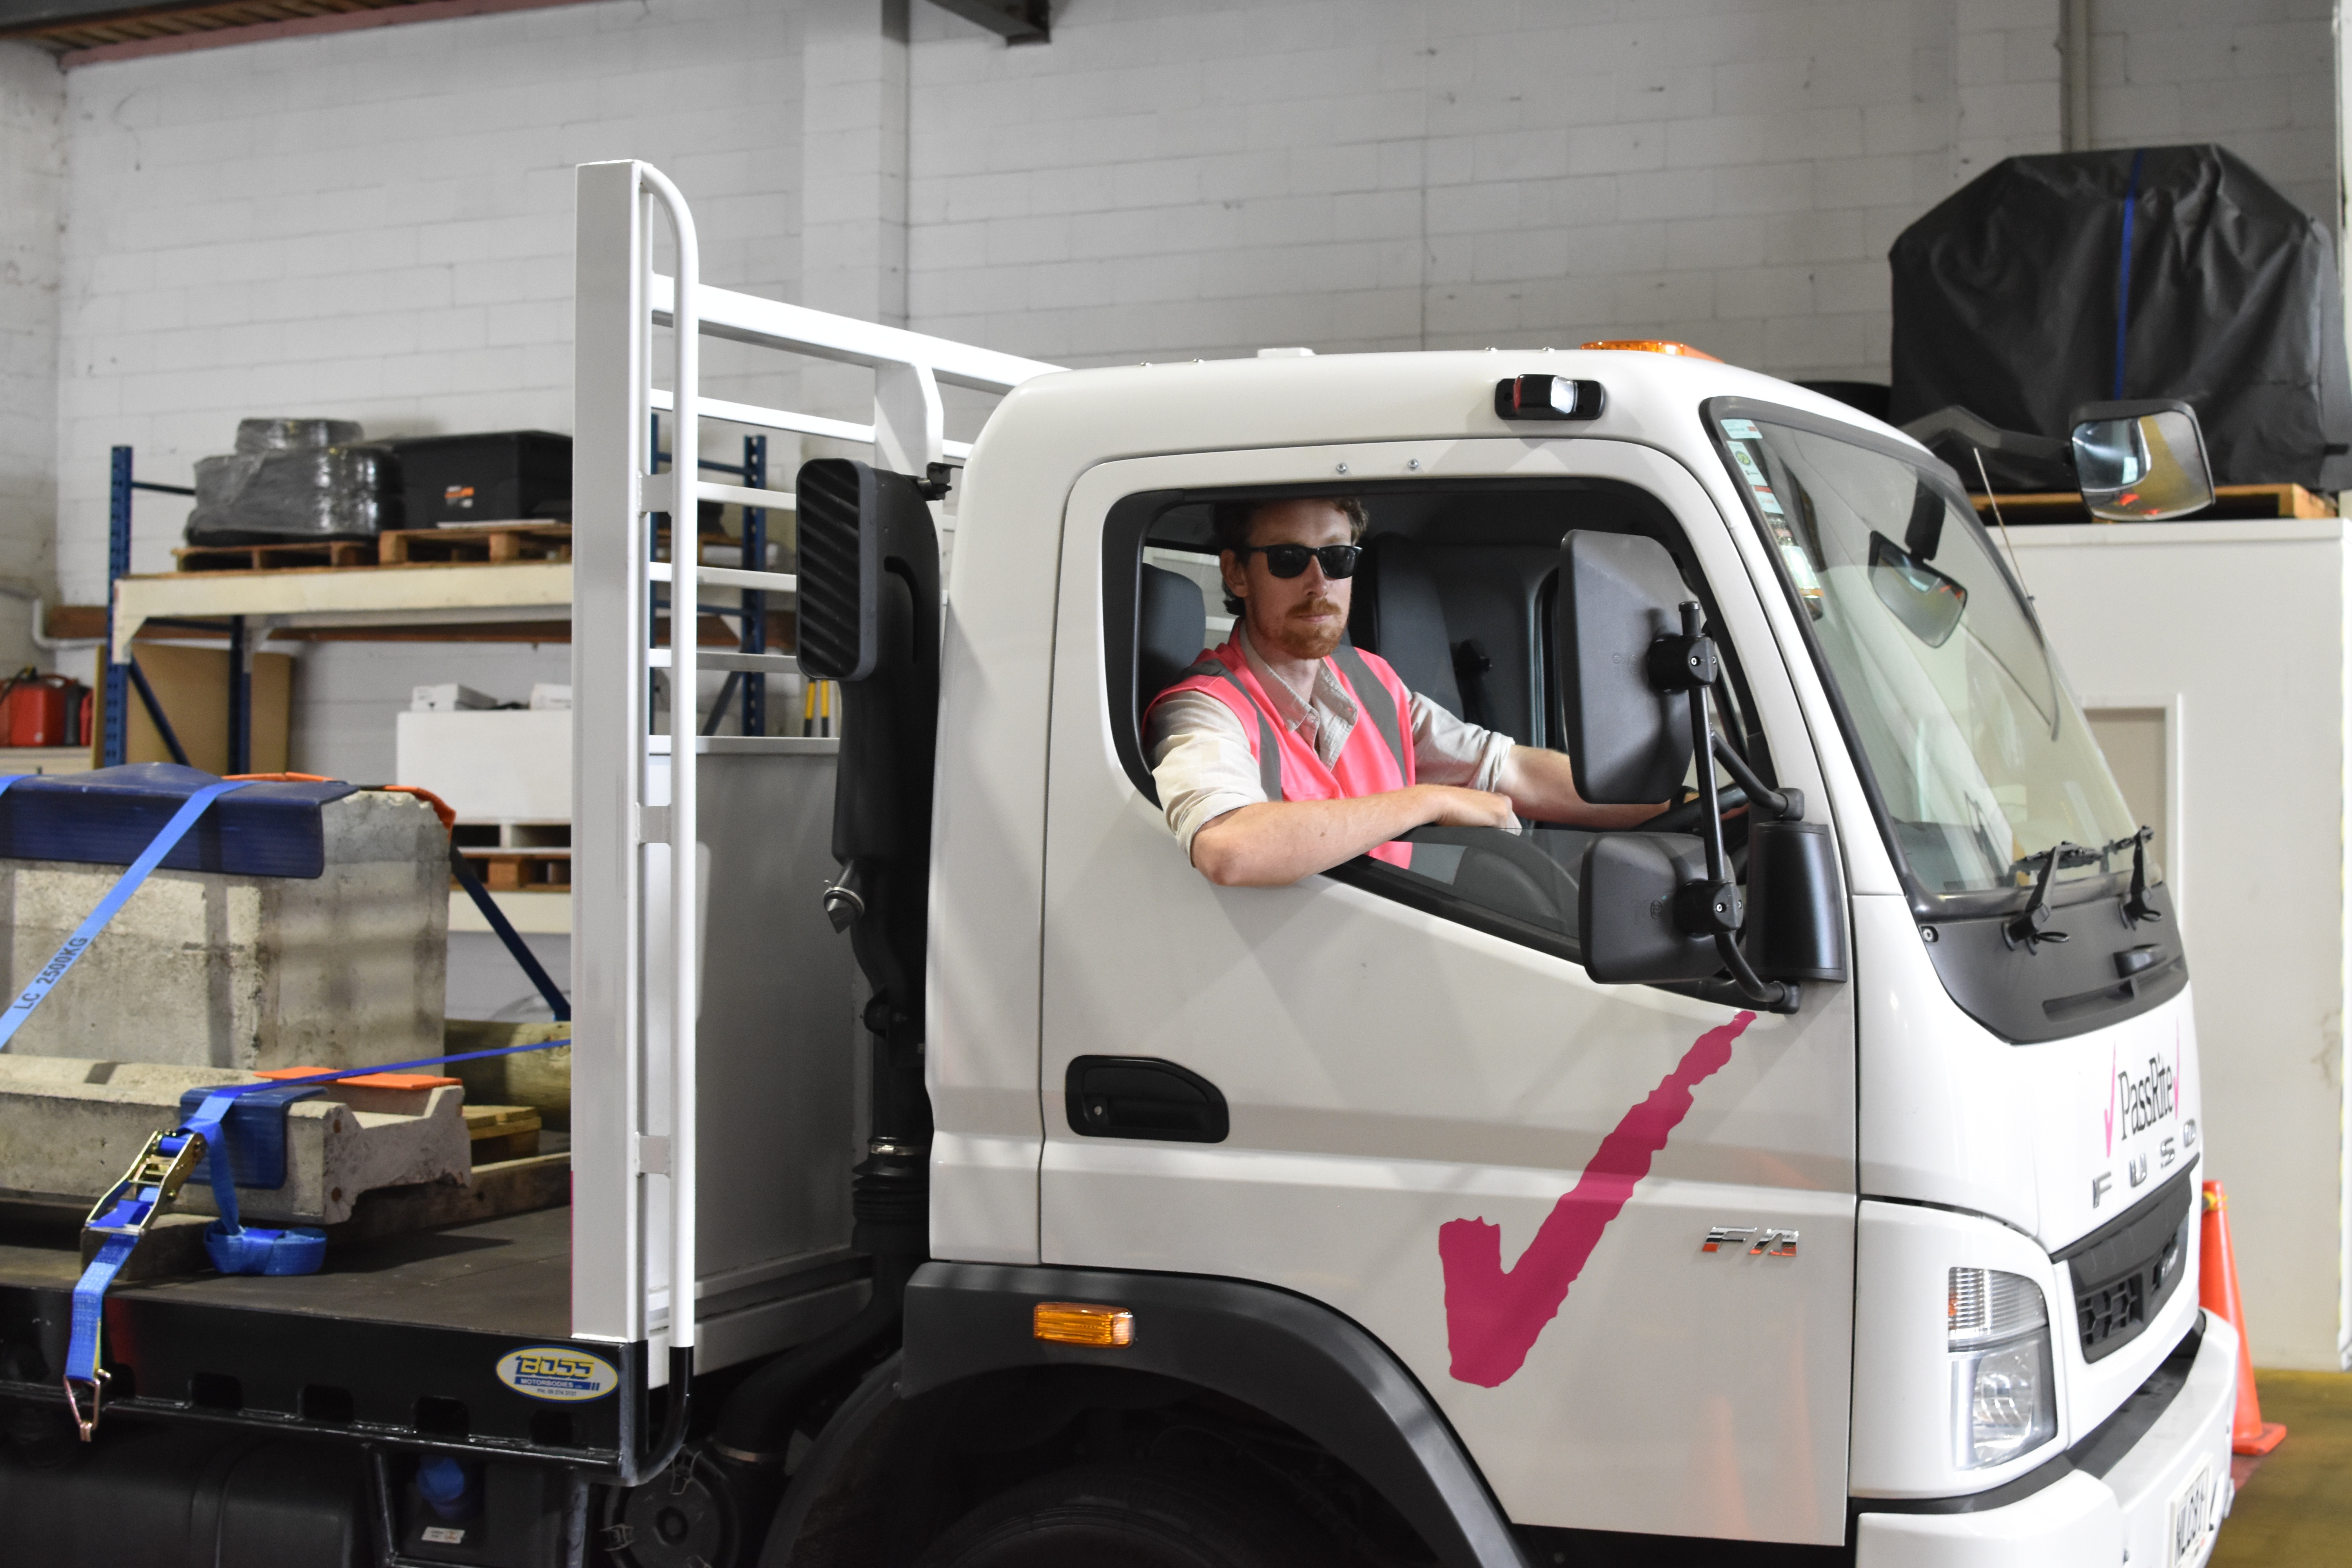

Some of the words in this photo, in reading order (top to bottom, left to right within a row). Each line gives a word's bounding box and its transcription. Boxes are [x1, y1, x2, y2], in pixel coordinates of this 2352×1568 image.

[13, 993, 40, 1010] LC
[36, 937, 89, 985] 2500KG
[2118, 1052, 2173, 1141] PassRite
[2092, 1119, 2196, 1209] FUSO
[515, 1355, 595, 1380] BOSS
